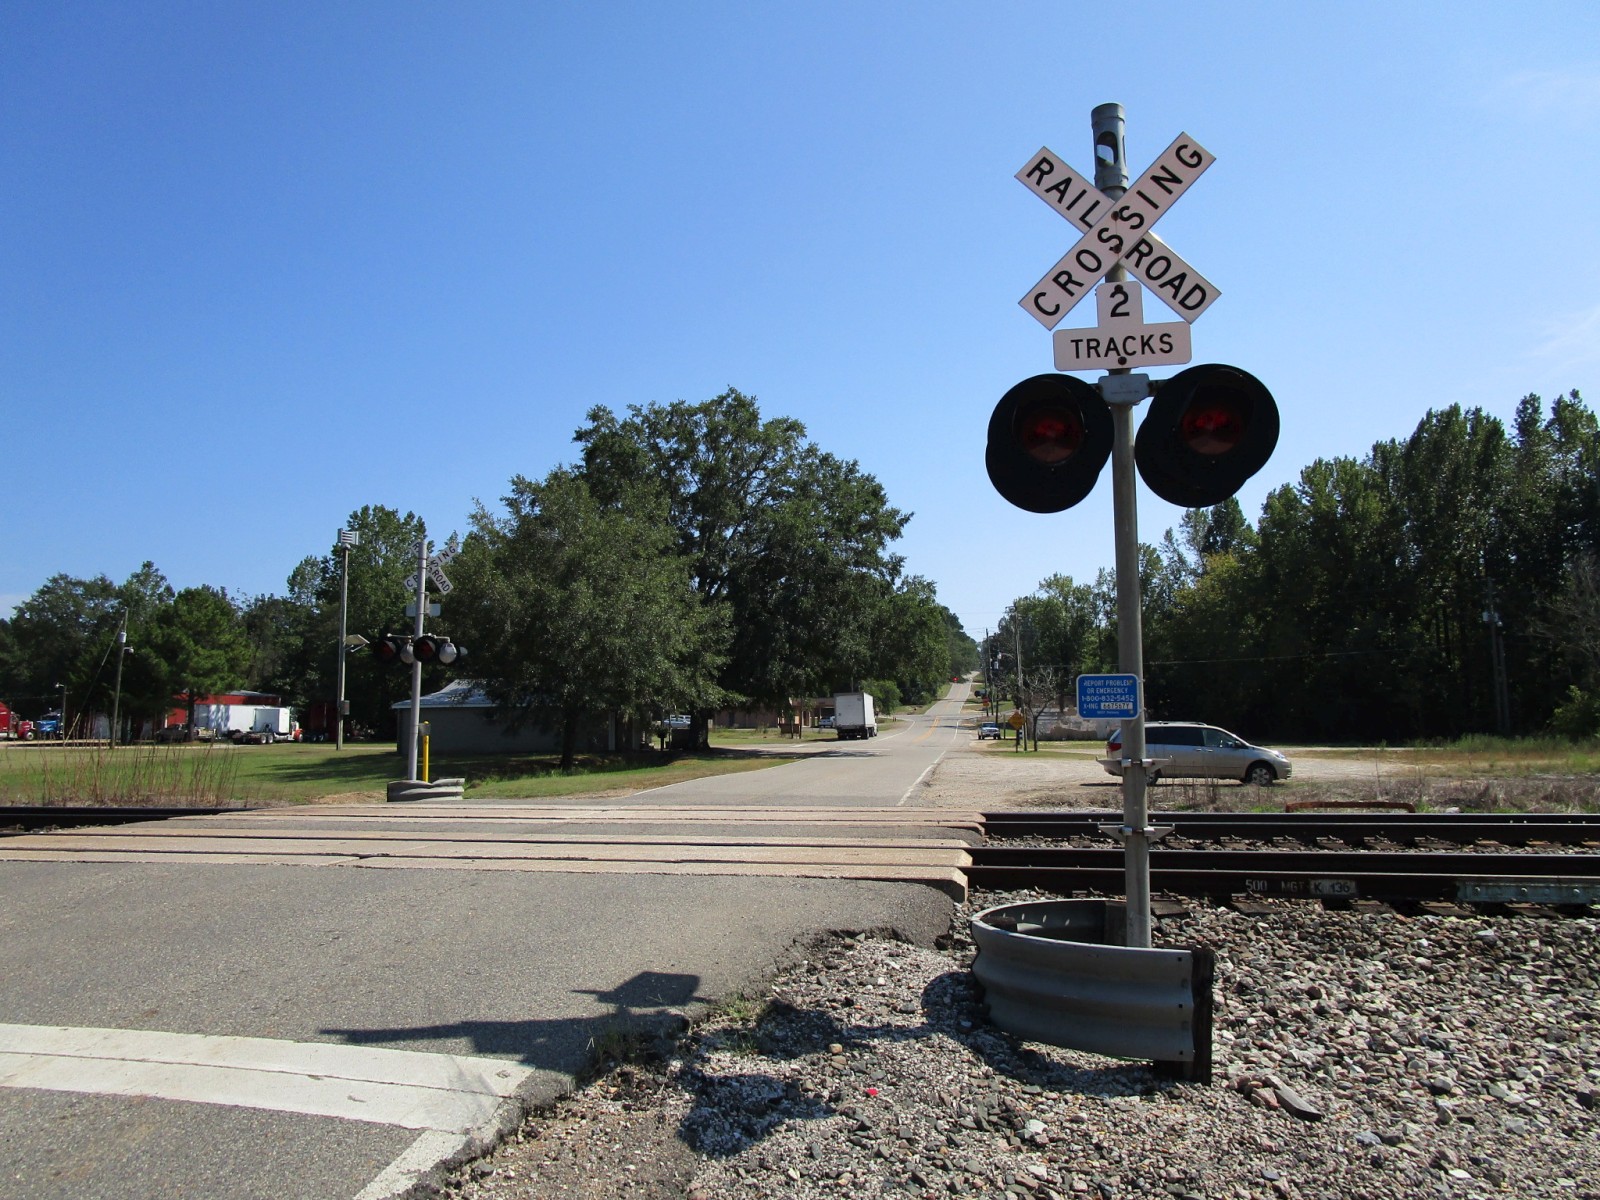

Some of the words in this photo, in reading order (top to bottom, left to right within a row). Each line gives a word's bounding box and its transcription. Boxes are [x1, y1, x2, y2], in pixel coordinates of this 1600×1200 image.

[1026, 156, 1101, 229] RAIL
[1125, 238, 1207, 311] ROAD
[1033, 144, 1203, 317] CROSSING
[1109, 290, 1130, 318] 2
[1070, 332, 1174, 360] TRACKS
[432, 570, 450, 592] ROAD
[1245, 879, 1268, 891] 500
